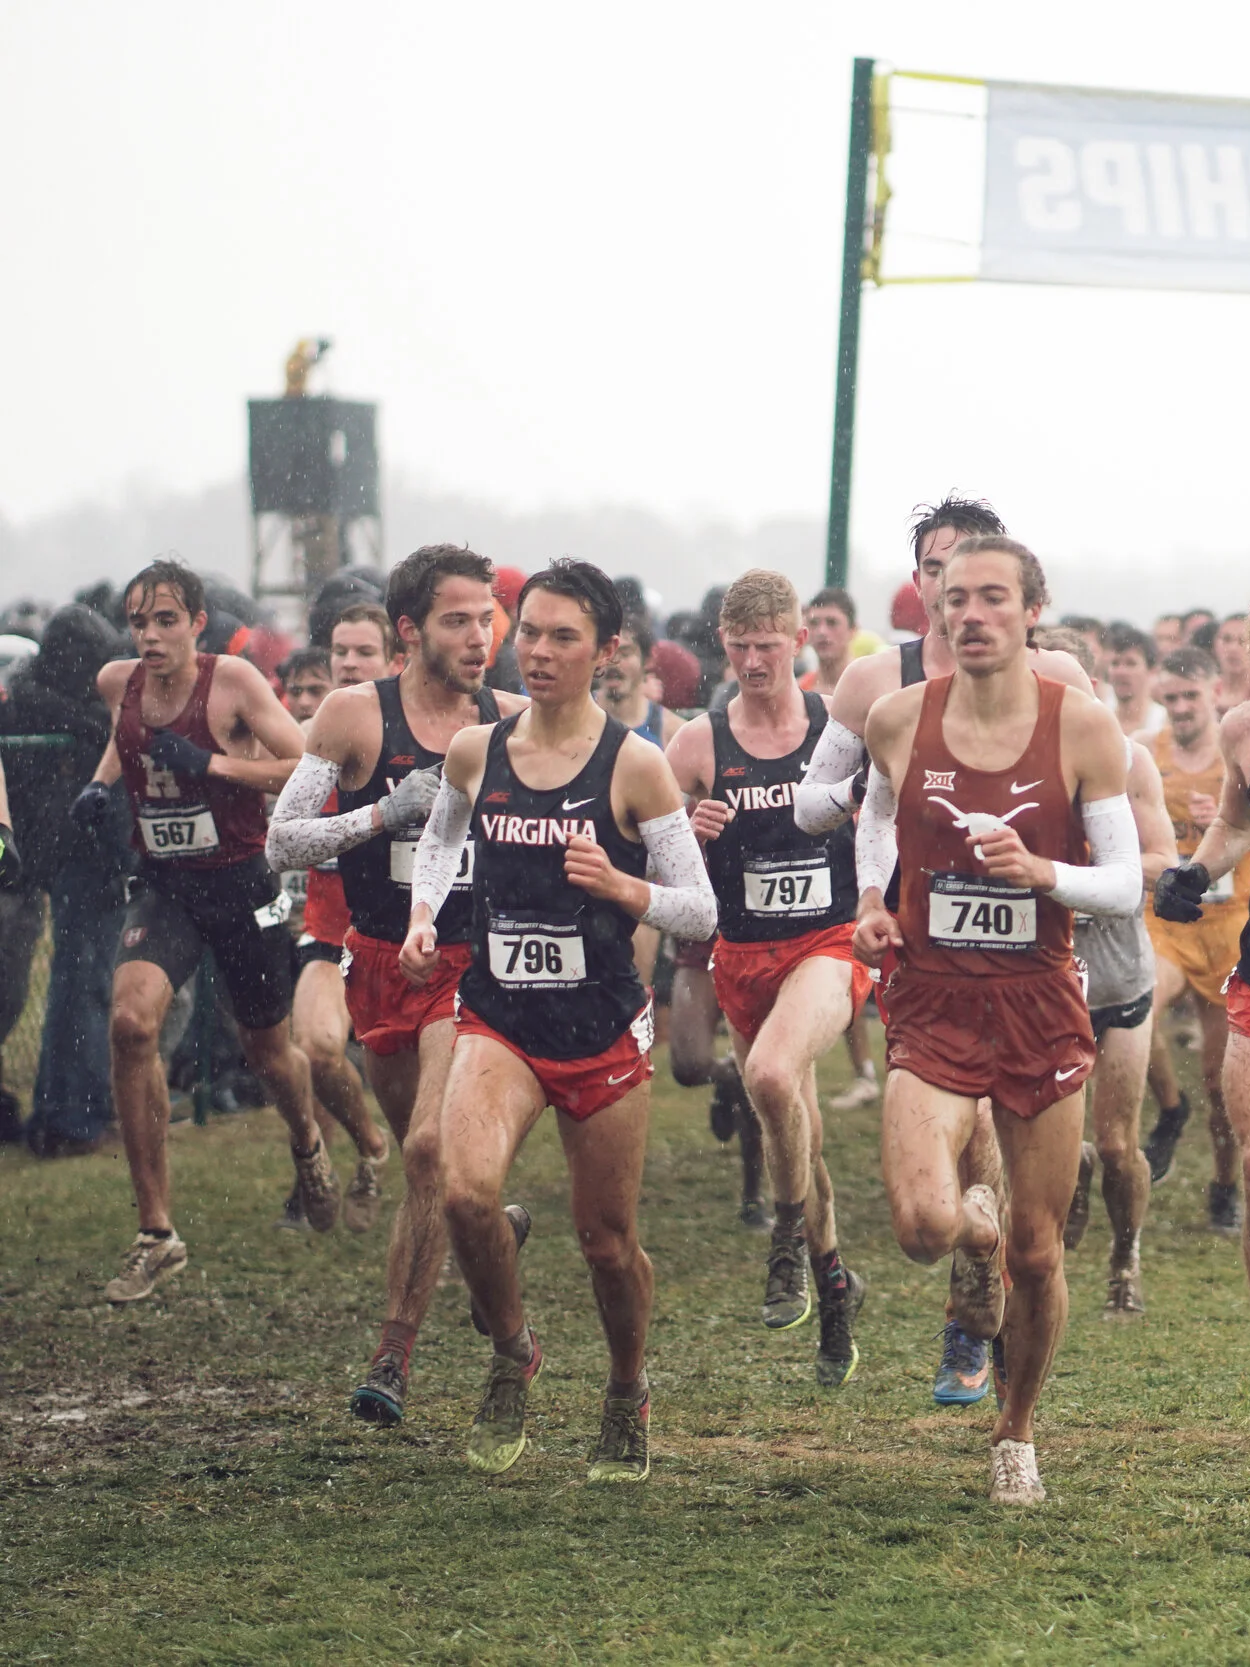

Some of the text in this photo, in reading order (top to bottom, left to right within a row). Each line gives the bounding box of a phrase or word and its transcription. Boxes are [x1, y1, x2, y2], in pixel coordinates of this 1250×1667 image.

[388, 755, 416, 765] ACC
[722, 767, 746, 776] ACC
[152, 821, 196, 848] 567
[760, 875, 813, 906] 797
[964, 884, 988, 892] COUNTRY
[951, 901, 1014, 935] 740
[503, 939, 563, 975] 796
